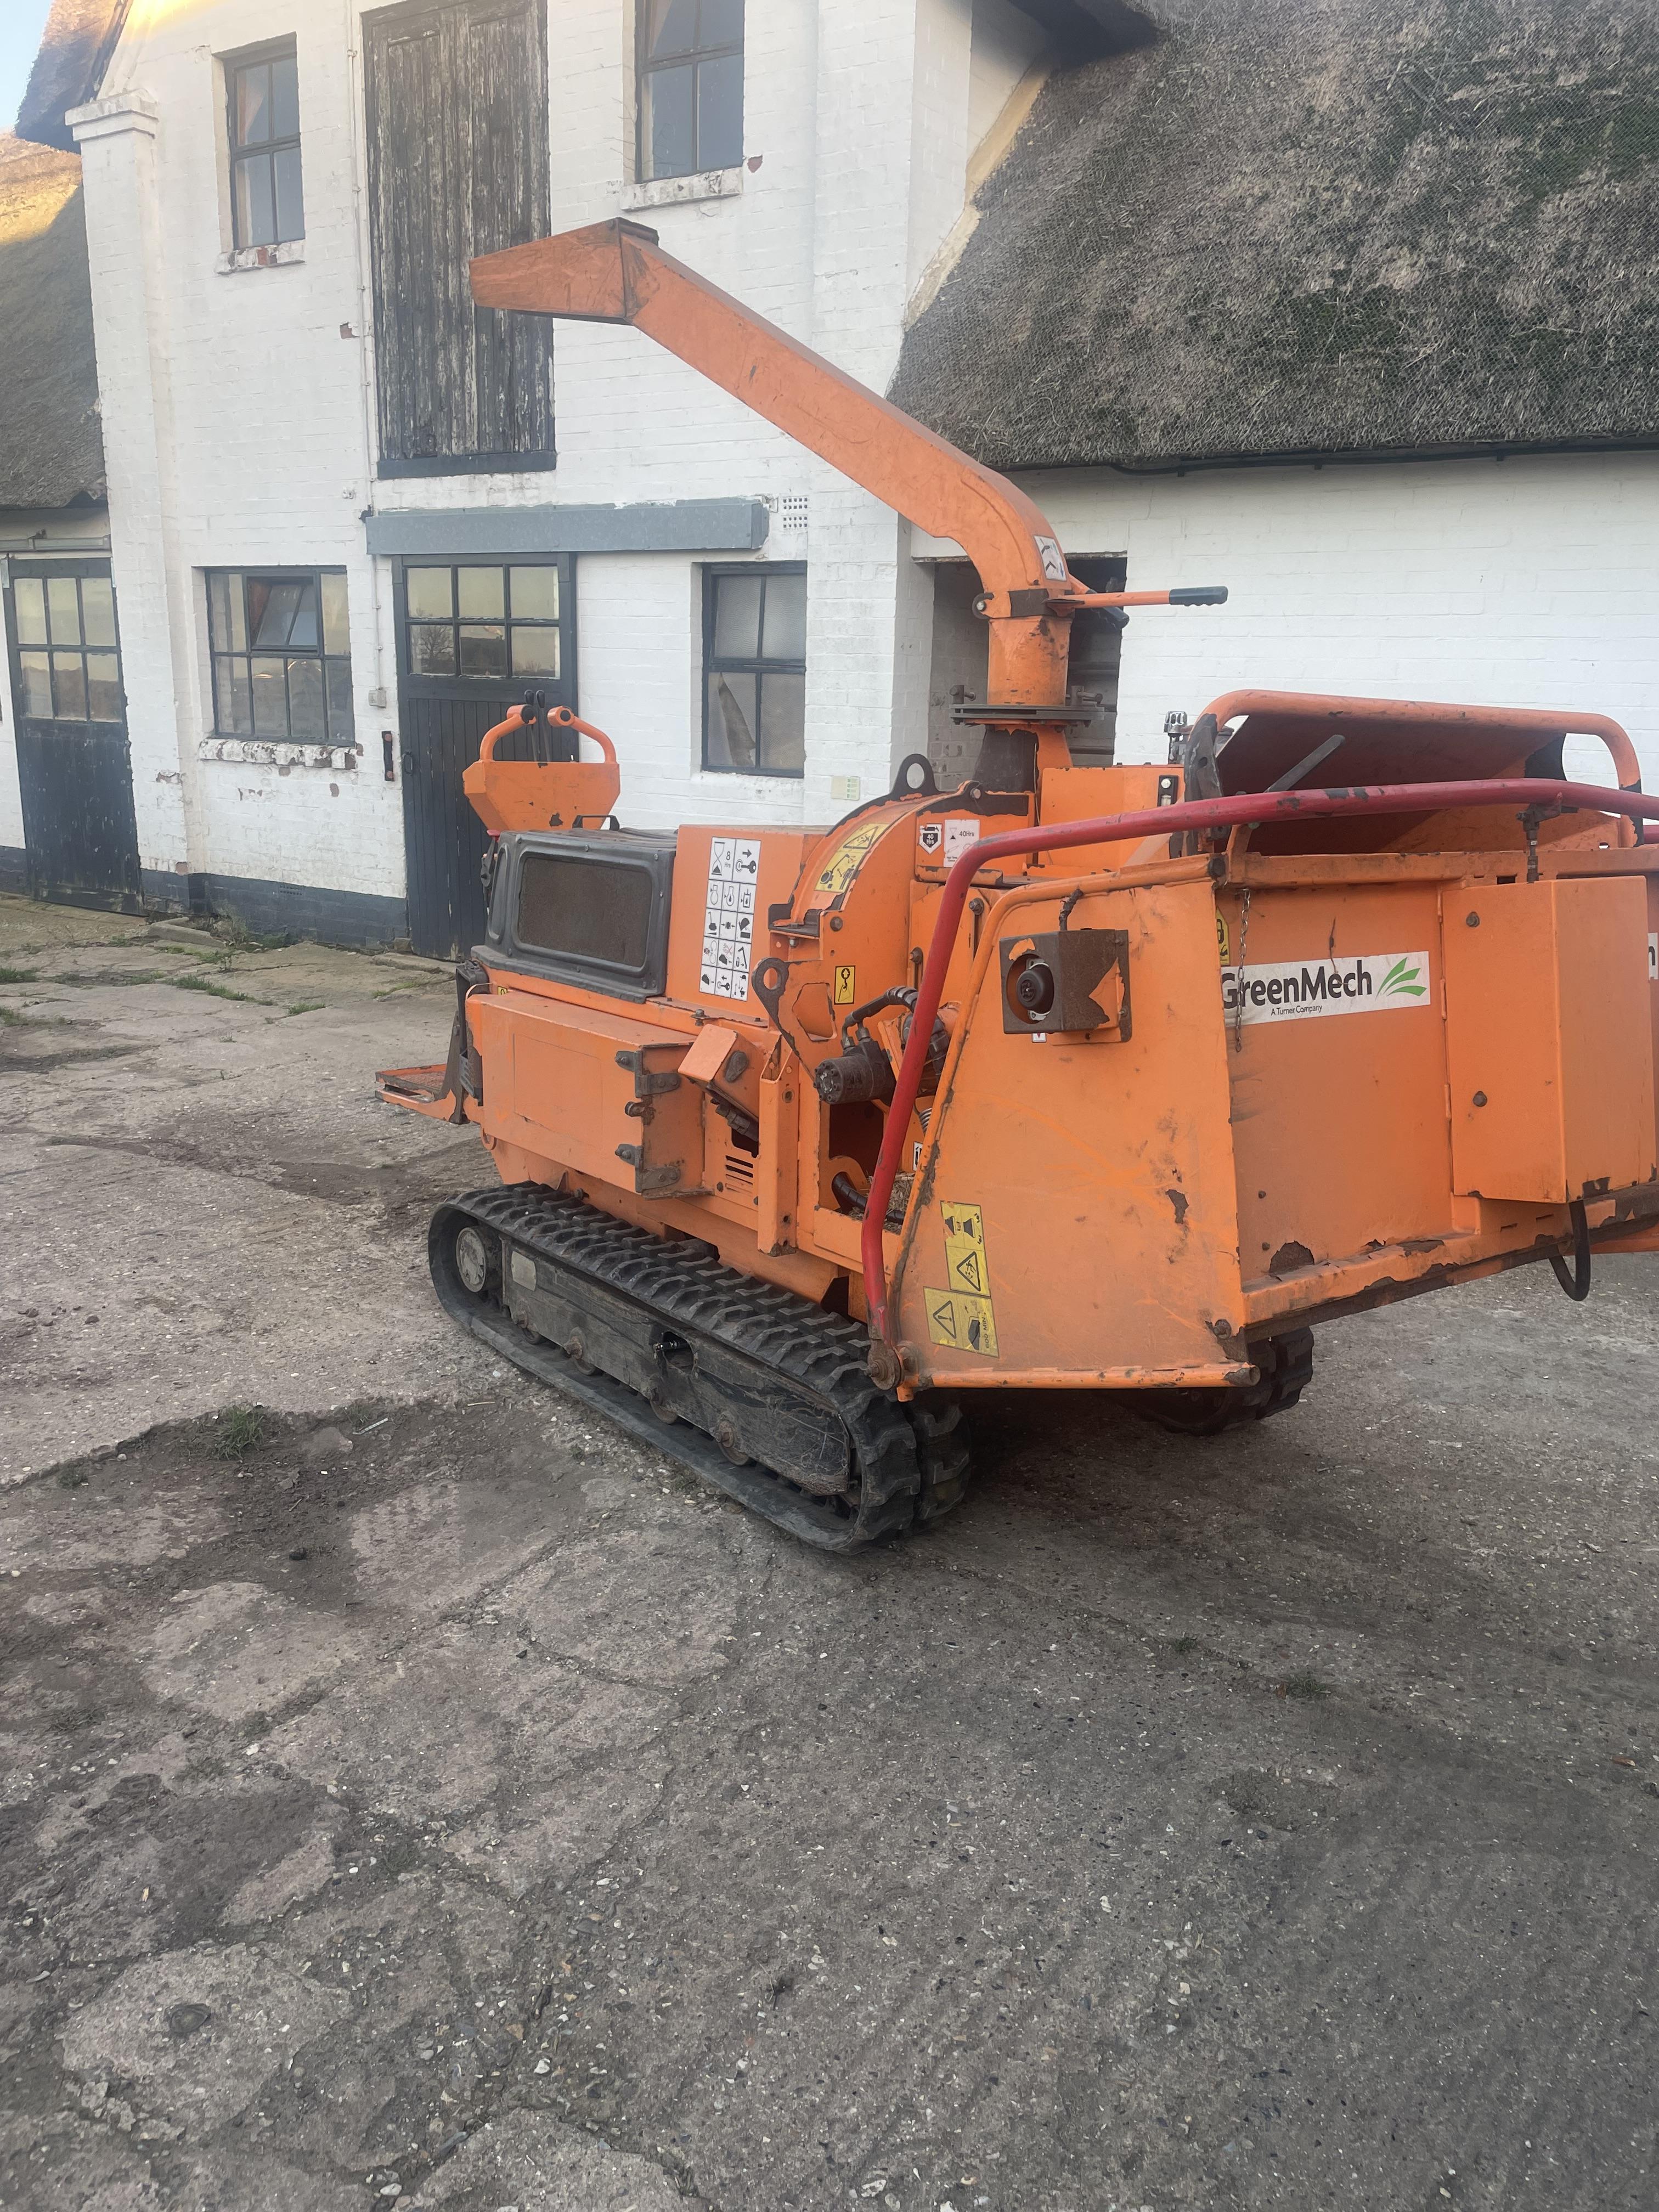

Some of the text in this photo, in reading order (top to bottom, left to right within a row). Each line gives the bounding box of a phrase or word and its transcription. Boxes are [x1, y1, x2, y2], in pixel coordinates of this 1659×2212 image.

[726, 851, 731, 861] 8
[1221, 960, 1372, 1009] GreenMech
[1271, 1005, 1323, 1016] A Turner Company
